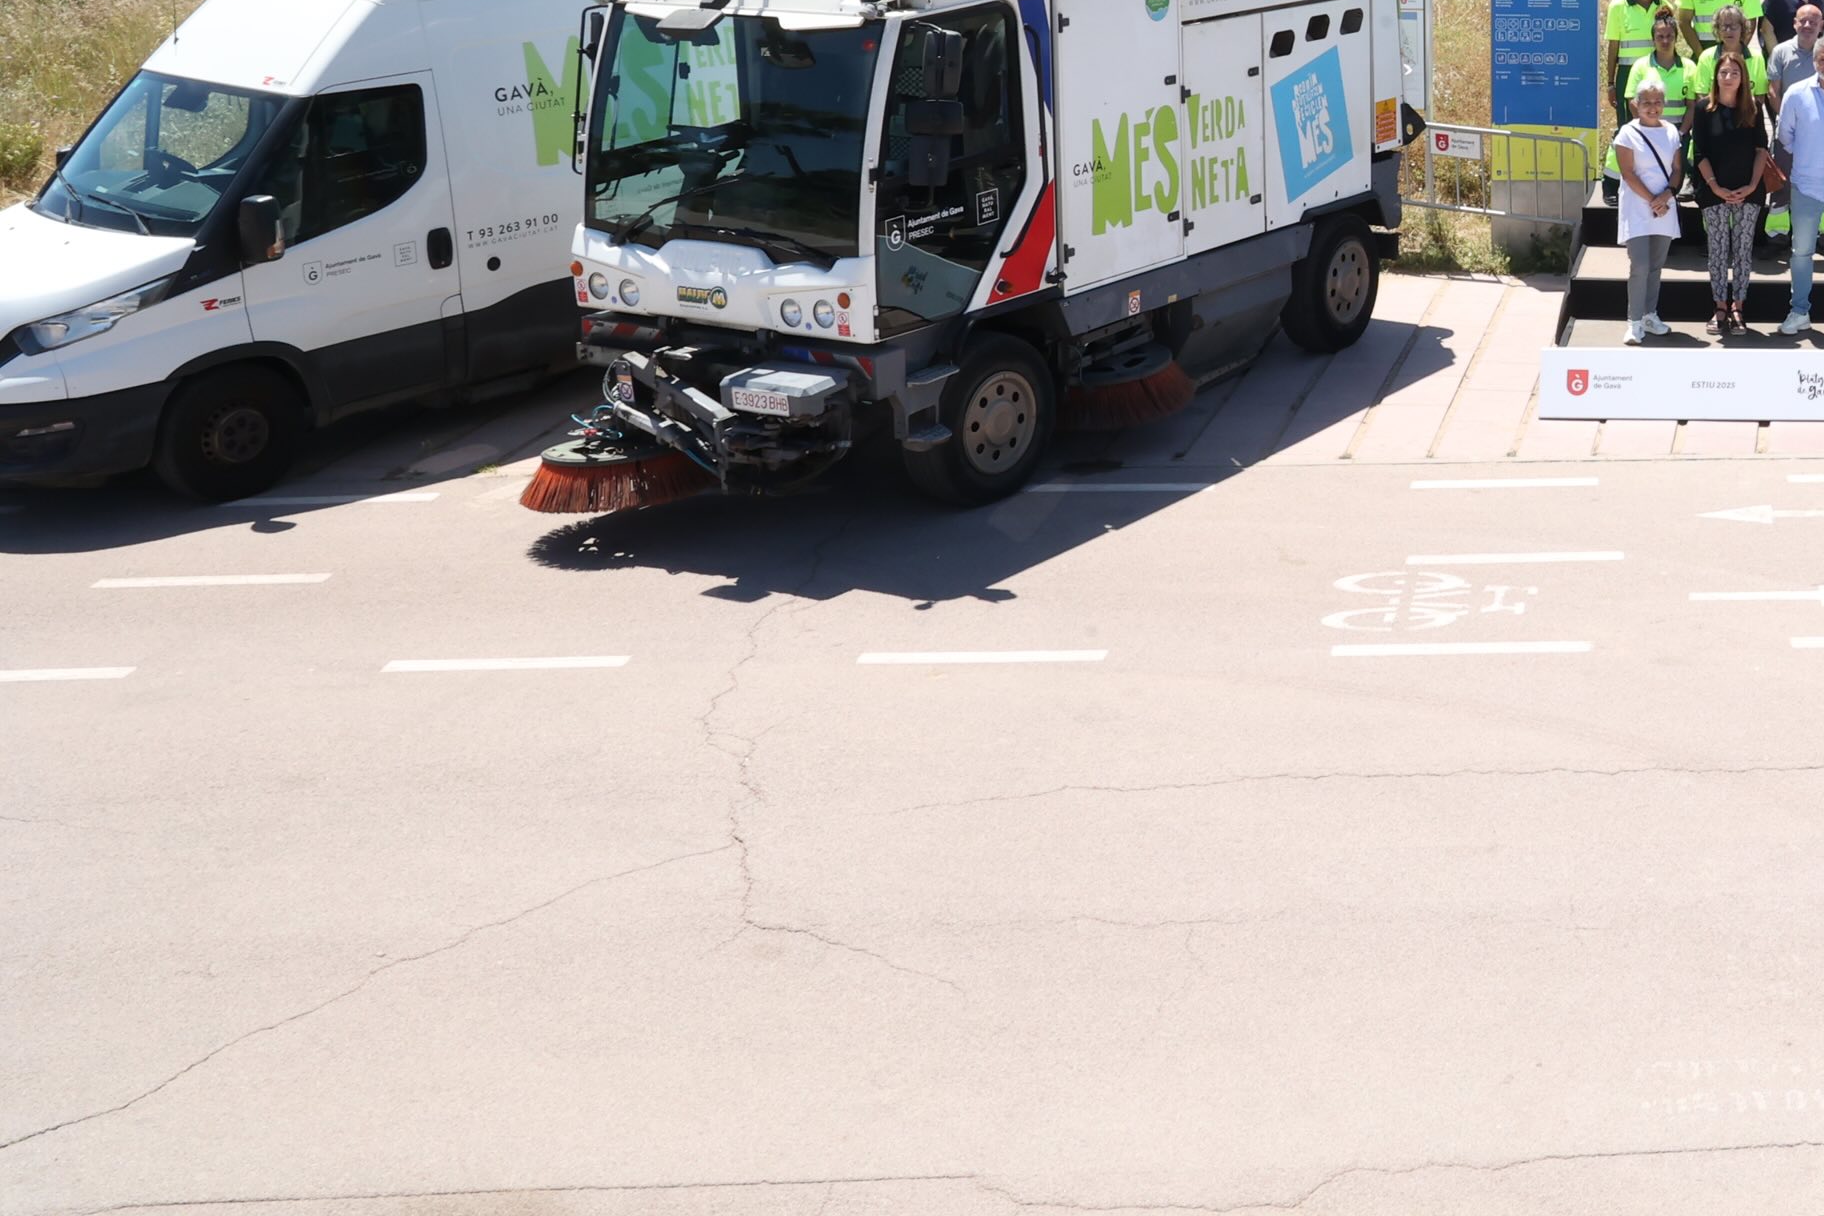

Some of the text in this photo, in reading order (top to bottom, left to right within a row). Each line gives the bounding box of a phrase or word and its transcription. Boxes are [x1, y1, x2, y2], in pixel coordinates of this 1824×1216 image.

[497, 96, 567, 117] UNA CIUTAT
[1187, 93, 1246, 150] VERDA
[1092, 104, 1180, 236] MÉS
[1191, 146, 1250, 211] NETA
[467, 213, 559, 241] T 93 263 91 00
[907, 212, 941, 228] Ajuntament
[941, 209, 949, 218] de
[908, 226, 935, 241] PRESEC
[1593, 375, 1633, 383] Ajuntament
[1691, 381, 1736, 389] ESTIU 2025
